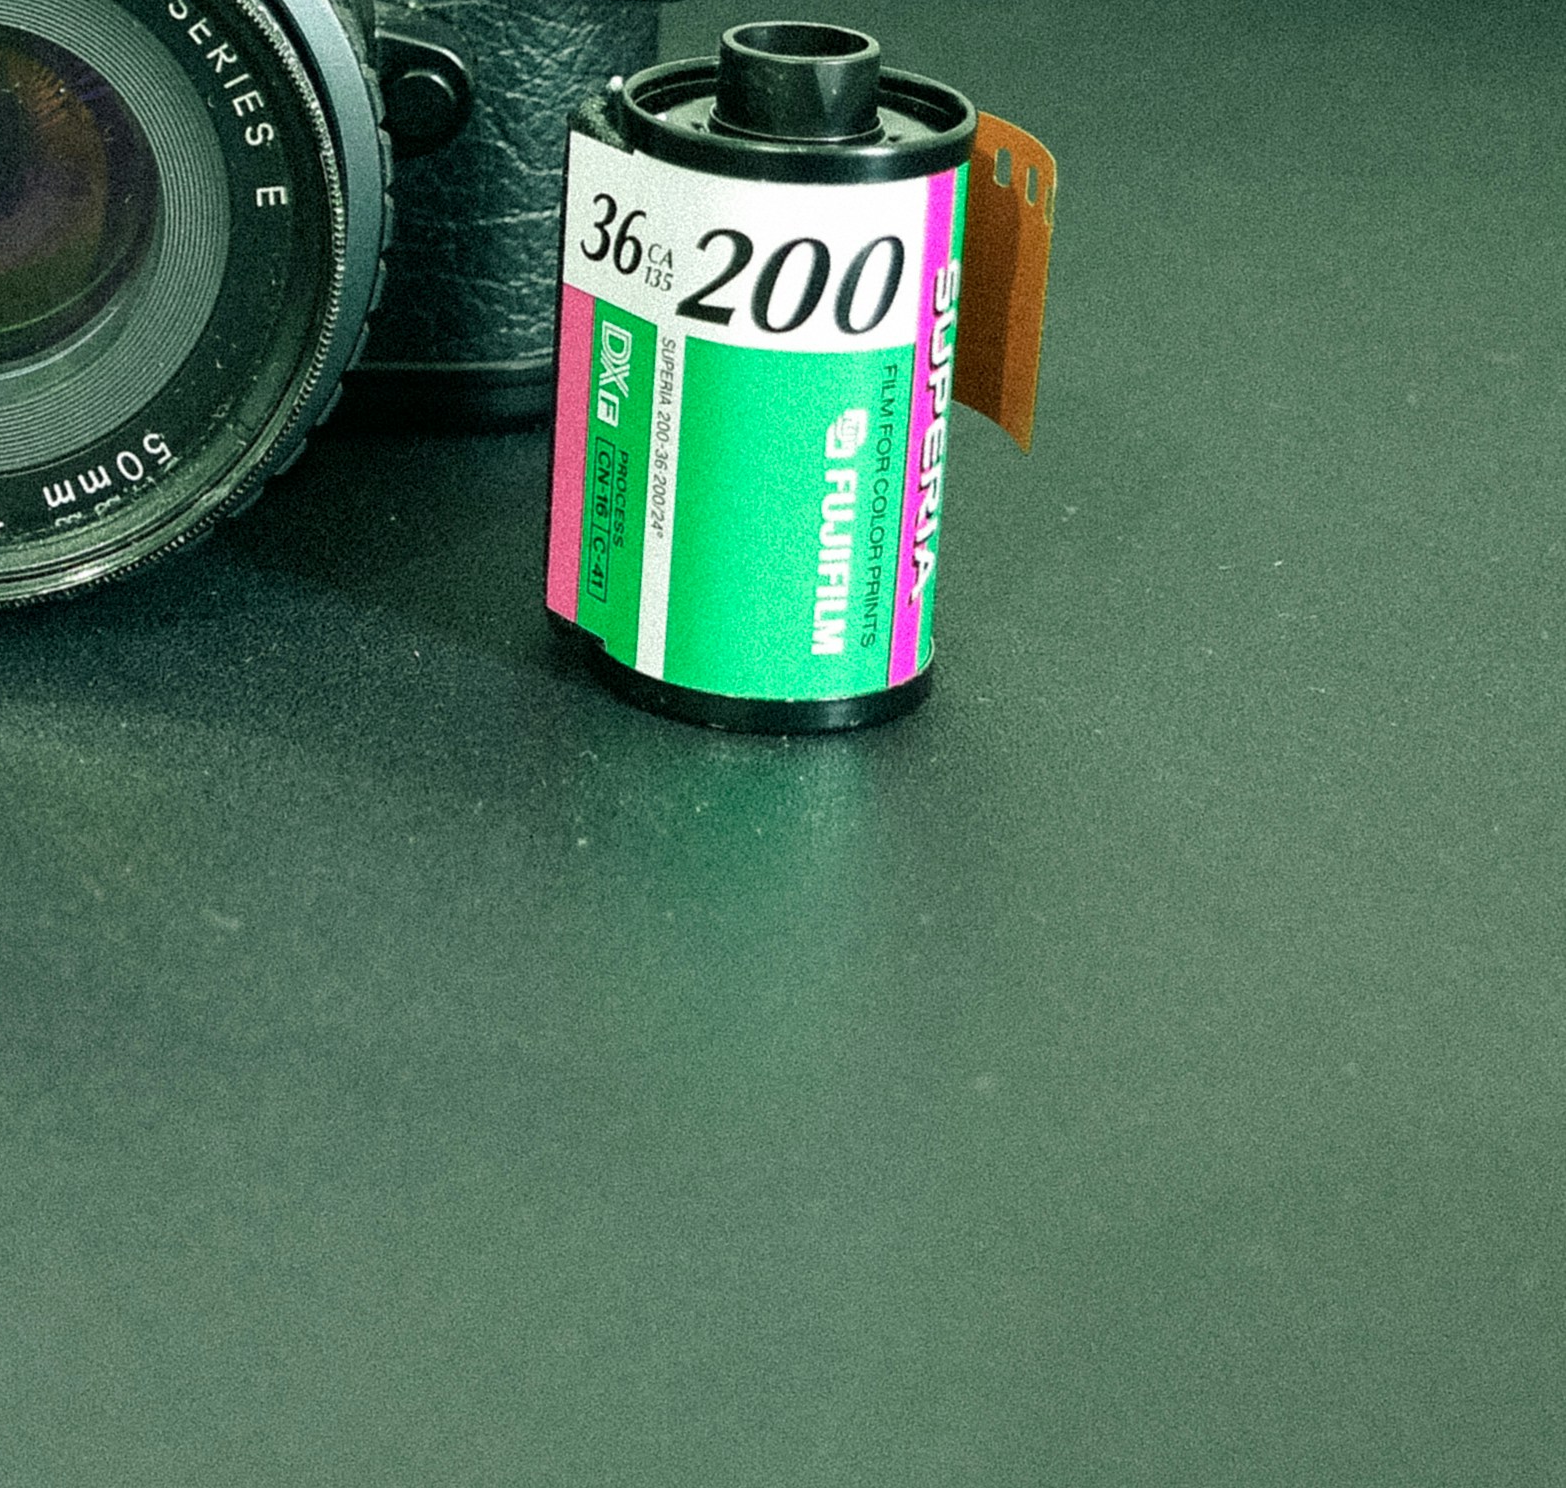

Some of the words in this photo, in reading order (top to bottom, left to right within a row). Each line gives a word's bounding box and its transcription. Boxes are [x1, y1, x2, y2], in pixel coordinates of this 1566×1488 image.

[256, 186, 288, 207] E
[580, 193, 647, 275] 36
[648, 244, 673, 269] CA
[644, 266, 673, 292] 135
[675, 228, 905, 335] 200
[659, 337, 676, 405] SUPERIA
[880, 364, 898, 417] FILM
[875, 423, 894, 474] FOR
[909, 260, 960, 607] SUPERIA
[42, 433, 173, 508] 50mm
[594, 450, 611, 518] CN-16
[613, 449, 629, 548] PROCESS
[868, 477, 890, 561] COLOR
[590, 536, 607, 589] C-41
[811, 469, 857, 655] FUJIFILM
[861, 566, 882, 648] PRINTS
